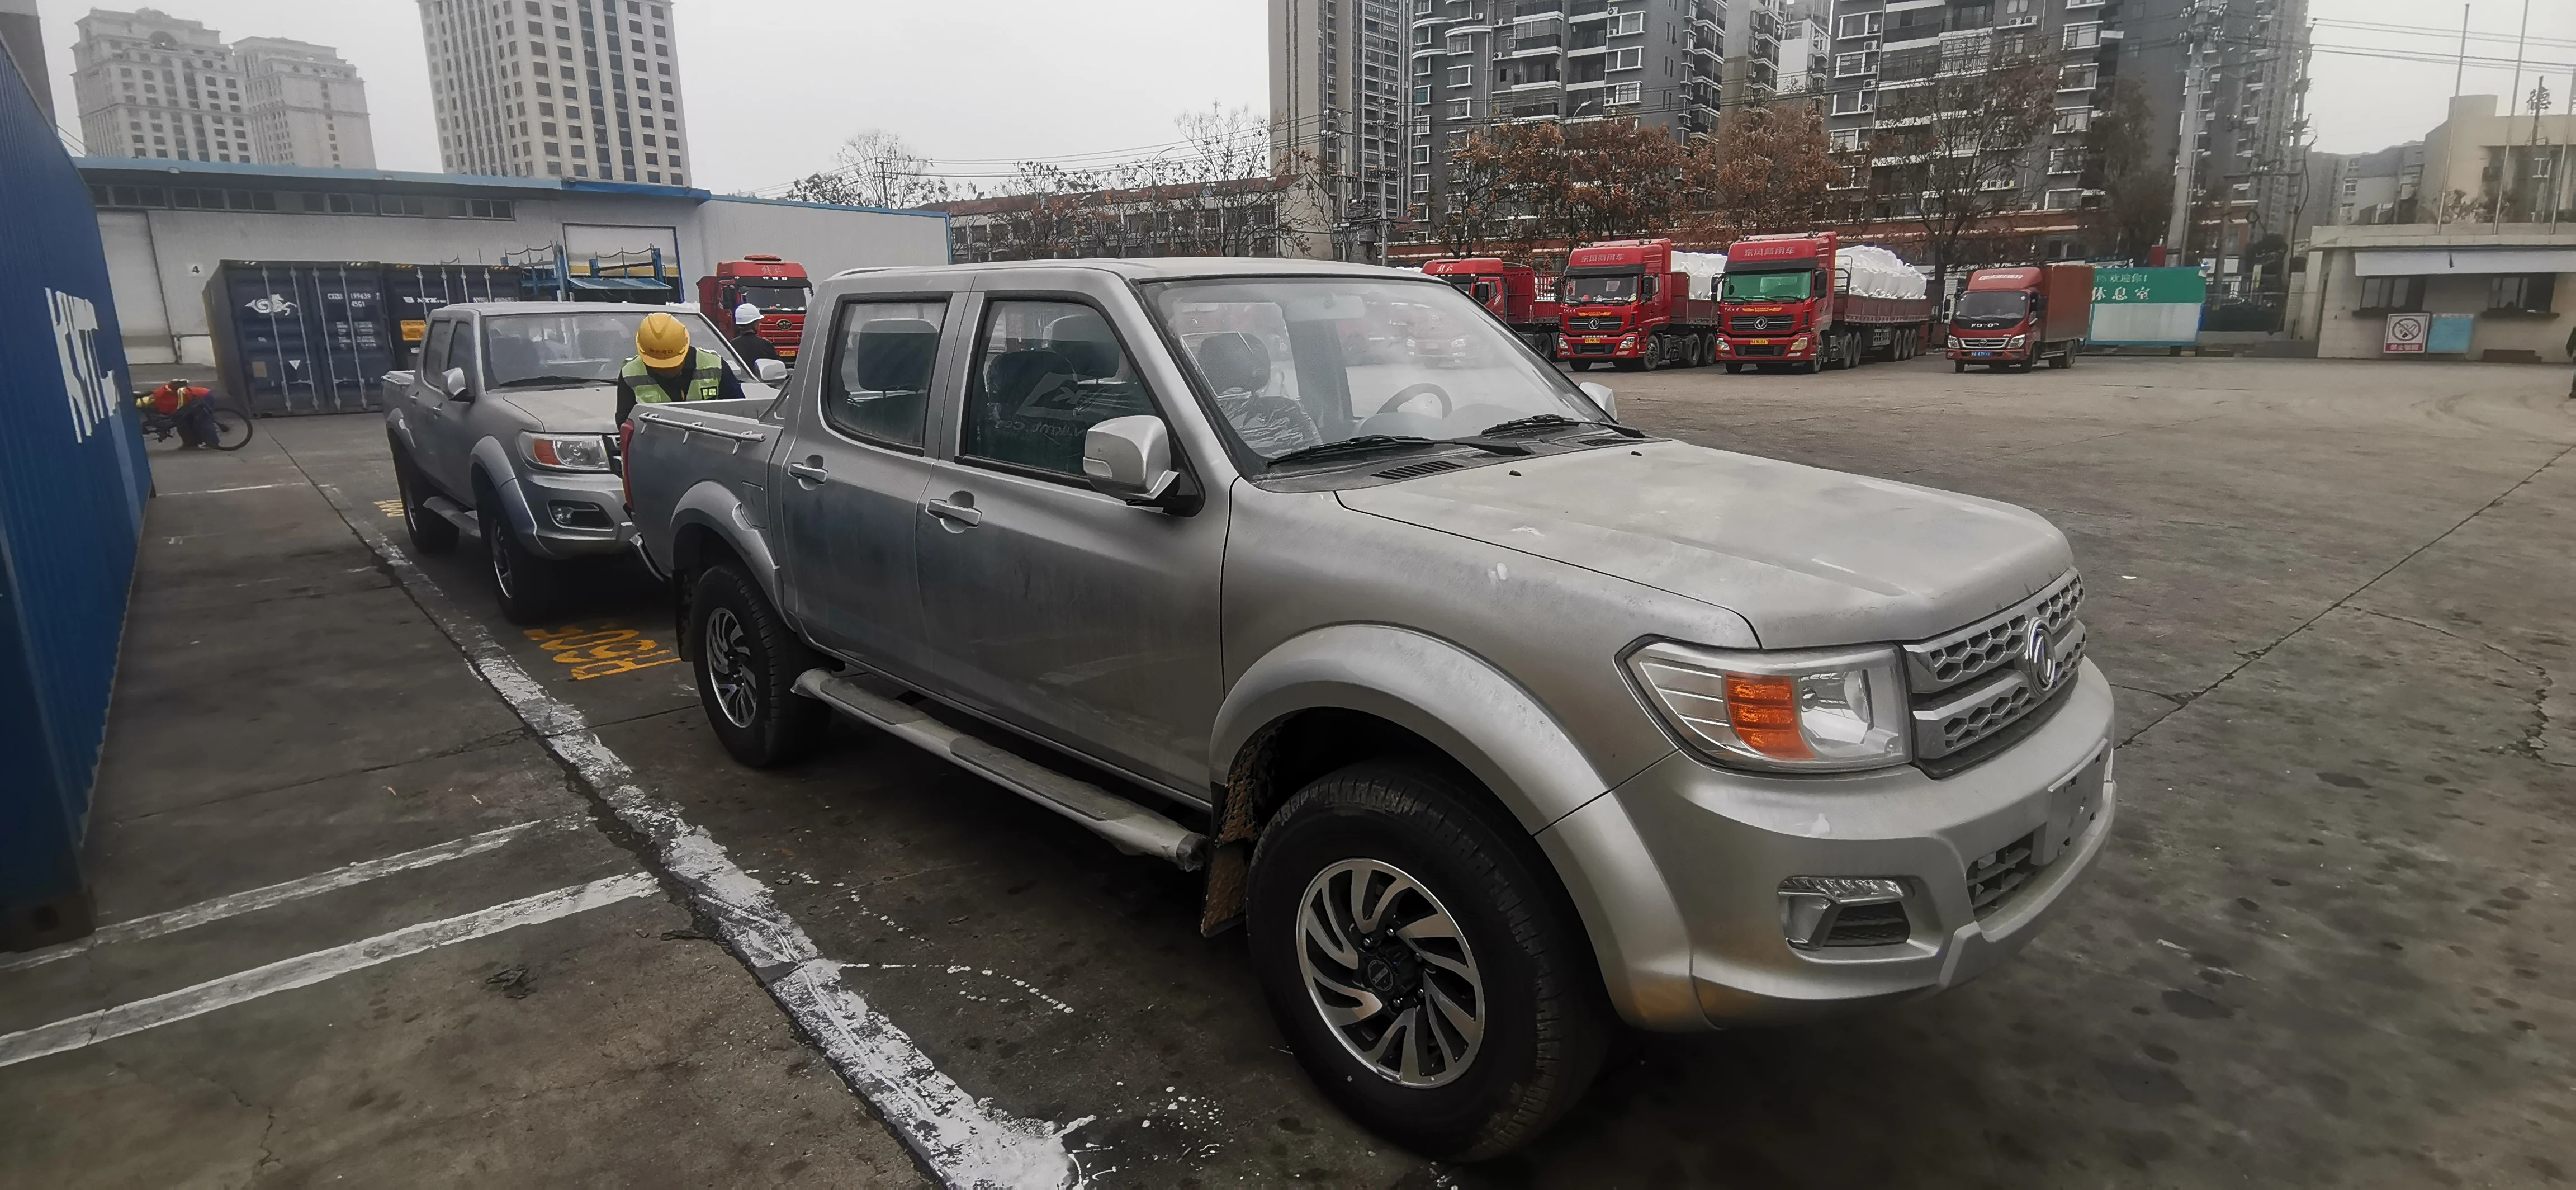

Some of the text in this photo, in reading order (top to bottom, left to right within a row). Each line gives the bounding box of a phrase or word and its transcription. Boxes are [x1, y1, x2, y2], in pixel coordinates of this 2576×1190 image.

[191, 265, 200, 273] 4
[2092, 286, 2151, 301] 休息室
